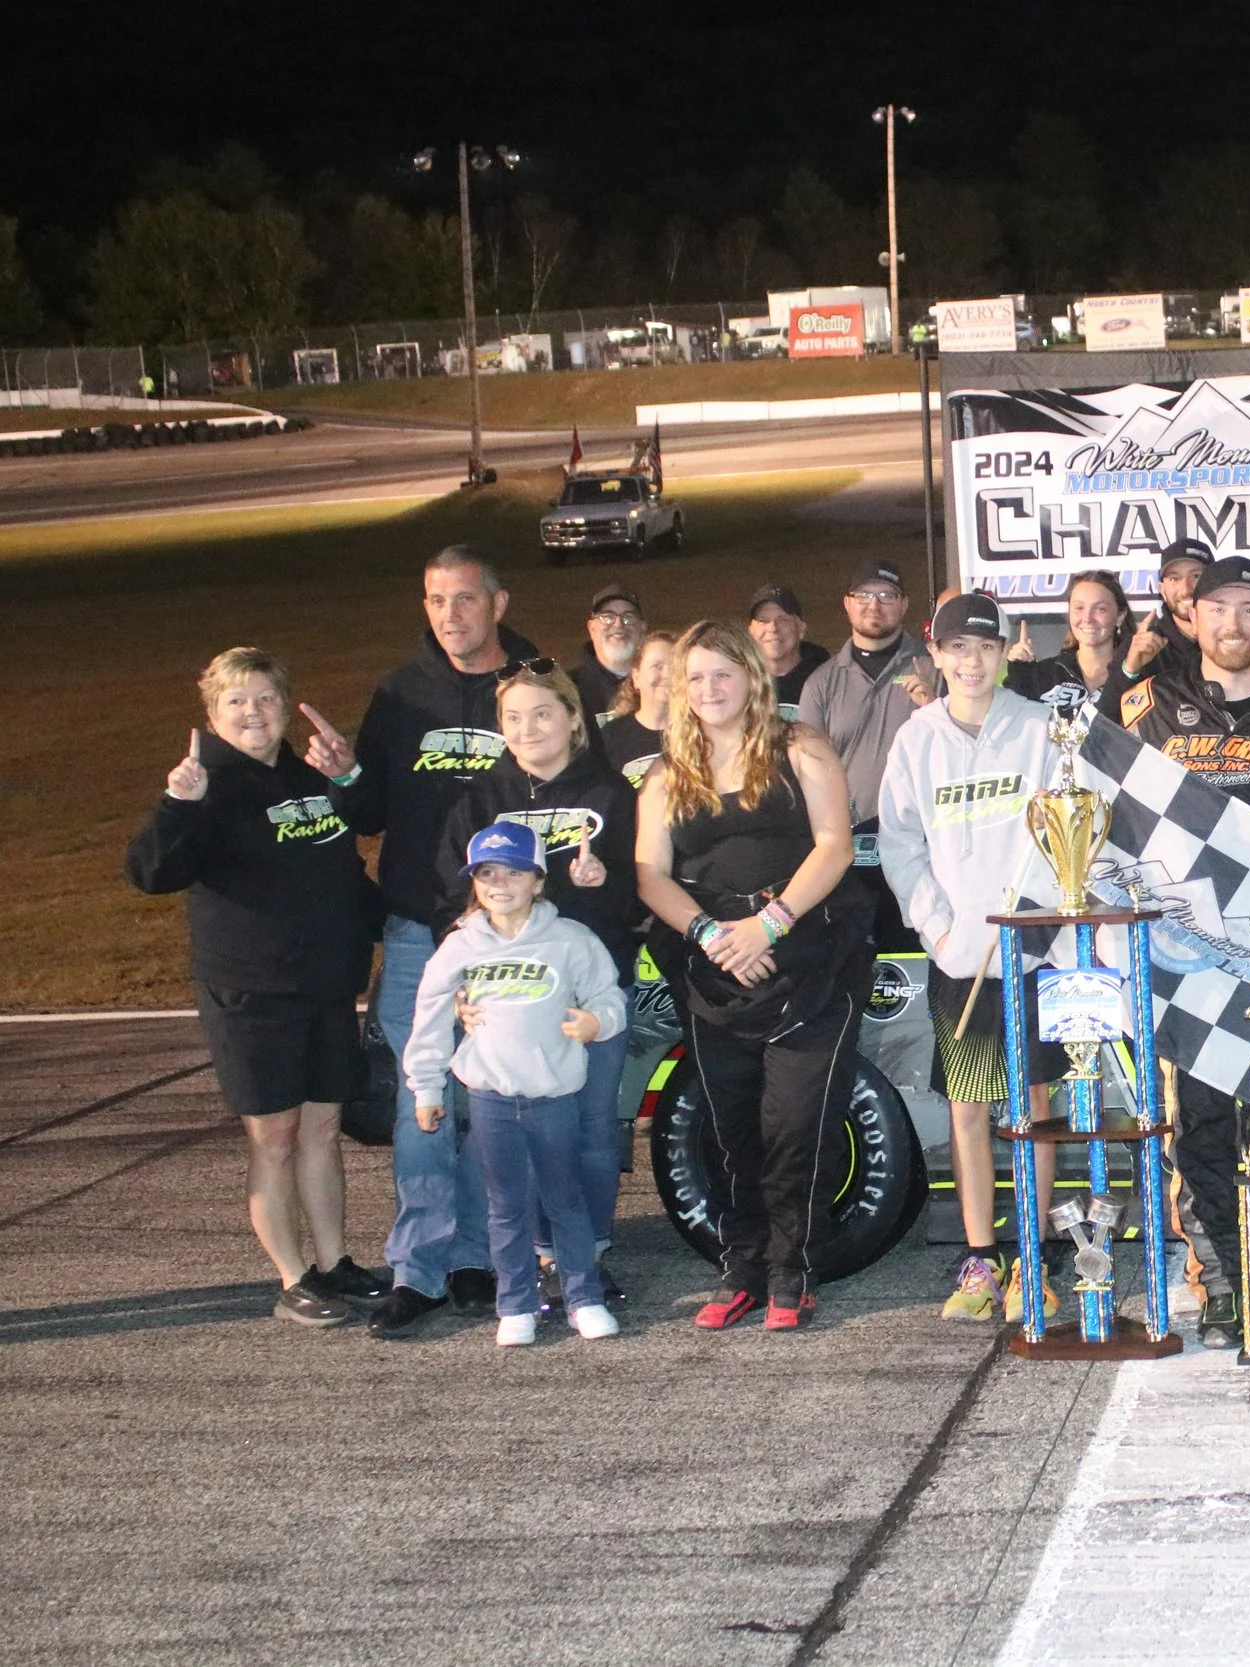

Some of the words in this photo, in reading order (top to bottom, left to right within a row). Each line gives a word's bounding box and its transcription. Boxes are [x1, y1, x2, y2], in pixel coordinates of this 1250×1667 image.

[798, 312, 851, 333] O'Reilly
[941, 304, 1011, 328] AVERY'S
[794, 338, 822, 350] AUTO
[823, 336, 857, 349] PARTS
[974, 450, 1054, 479] 2024
[1065, 437, 1162, 477] White
[1183, 760, 1220, 772] SONS
[1221, 760, 1250, 772] INC.
[935, 774, 1023, 806] GRAY
[849, 1079, 895, 1217] Hoosier
[662, 1095, 717, 1232] Hoosier
